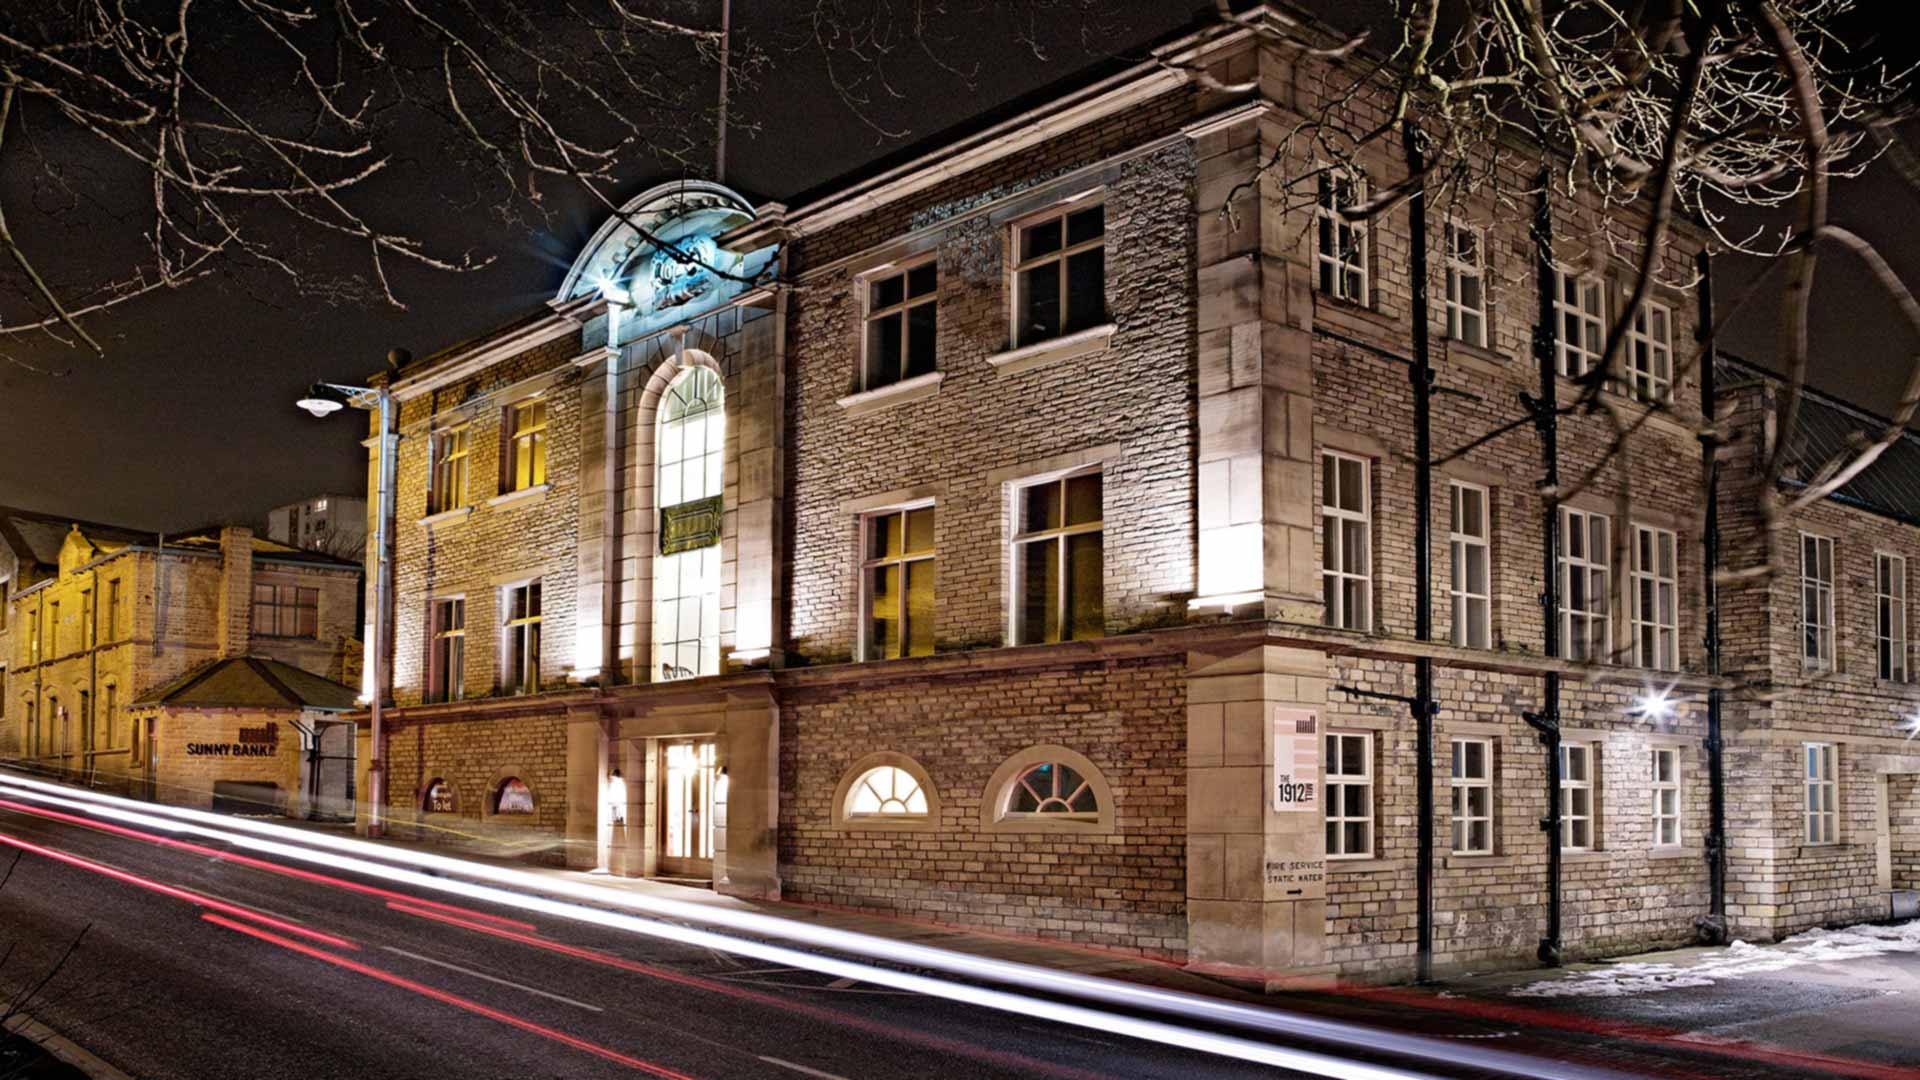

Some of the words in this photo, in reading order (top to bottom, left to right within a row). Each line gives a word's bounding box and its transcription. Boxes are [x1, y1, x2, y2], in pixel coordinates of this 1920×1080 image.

[186, 743, 230, 756] SUNNY
[232, 743, 267, 757] BANK
[1278, 783, 1305, 802] 1912
[1289, 861, 1323, 870] SERVICE
